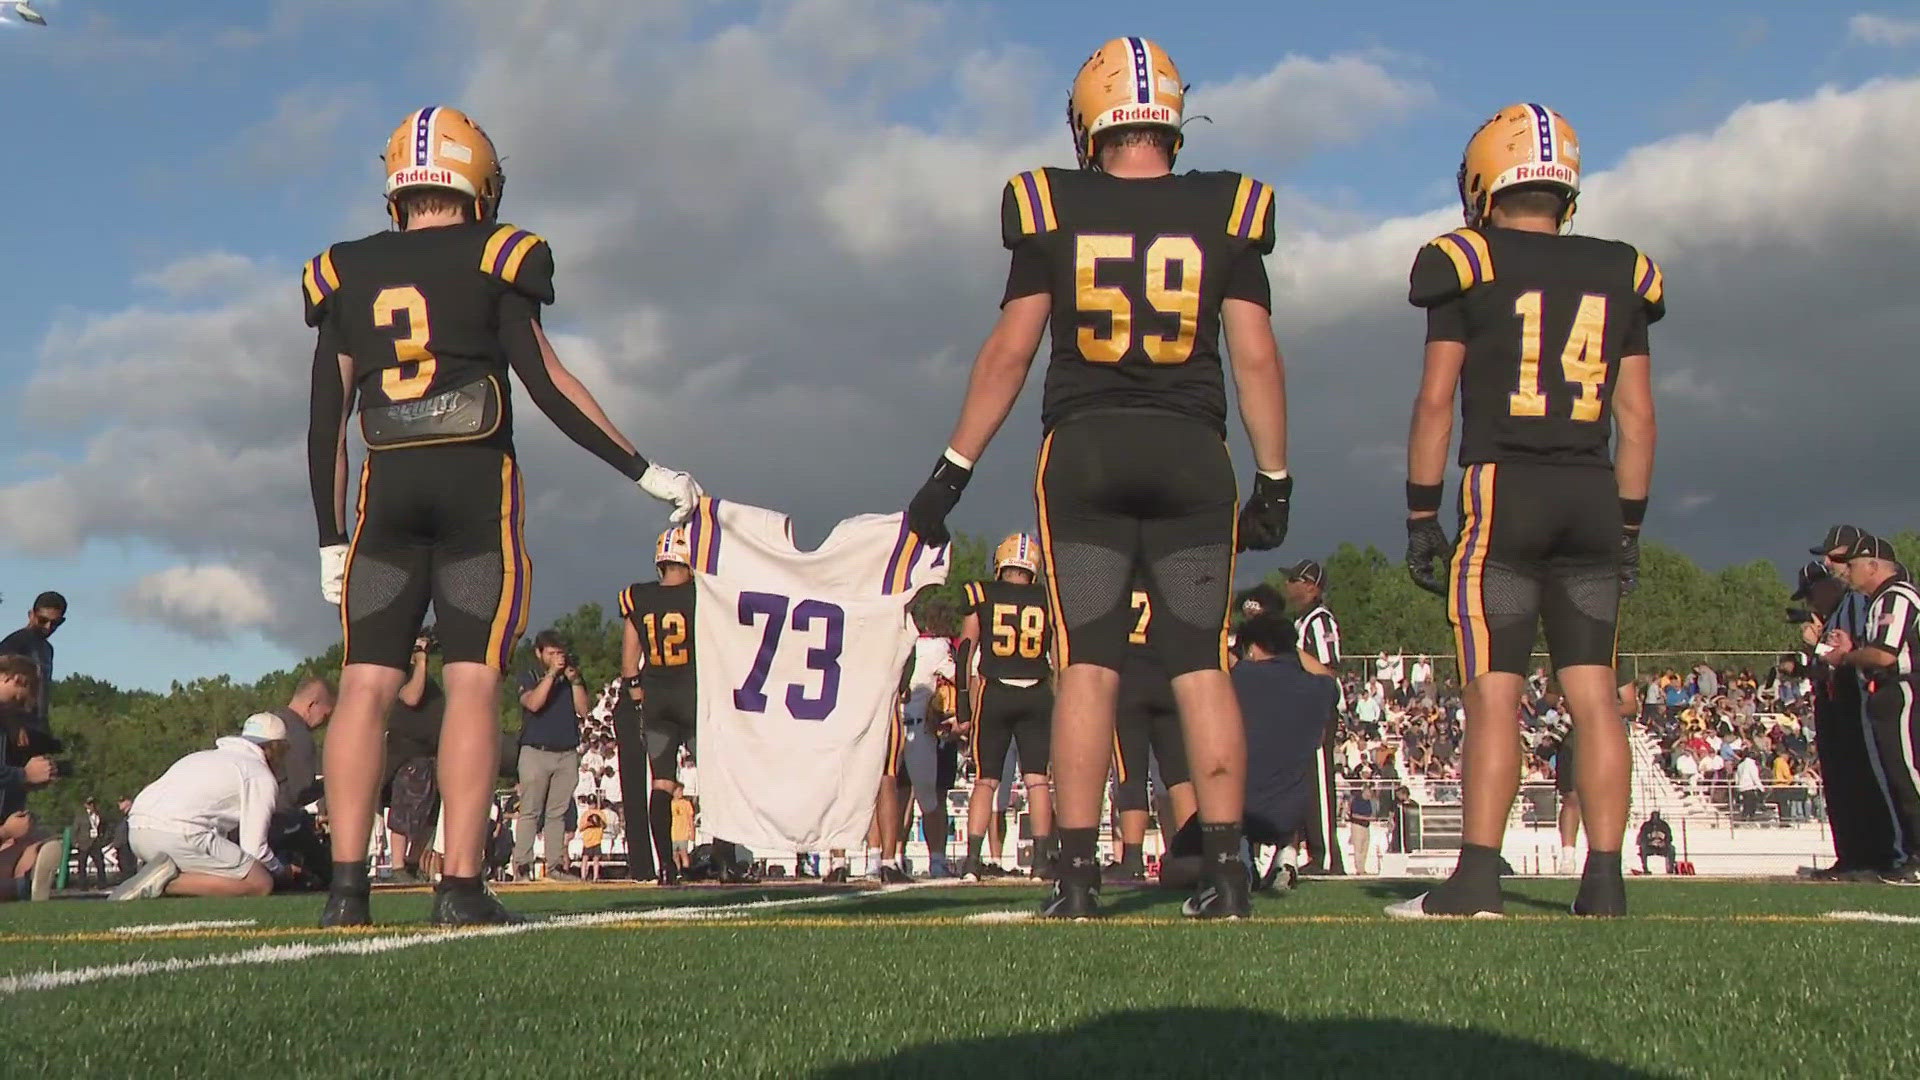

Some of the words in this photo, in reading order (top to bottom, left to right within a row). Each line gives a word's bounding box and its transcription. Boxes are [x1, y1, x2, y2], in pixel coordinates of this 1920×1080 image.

[1112, 108, 1170, 123] Riddell
[395, 169, 452, 186] Riddell
[1516, 165, 1573, 183] Riddell
[1074, 233, 1204, 363] 59
[373, 285, 437, 402] 3
[1509, 290, 1609, 423] 14
[643, 612, 689, 667] 12
[992, 603, 1045, 659] 58
[1129, 590, 1152, 645] 7
[733, 591, 845, 721] 73
